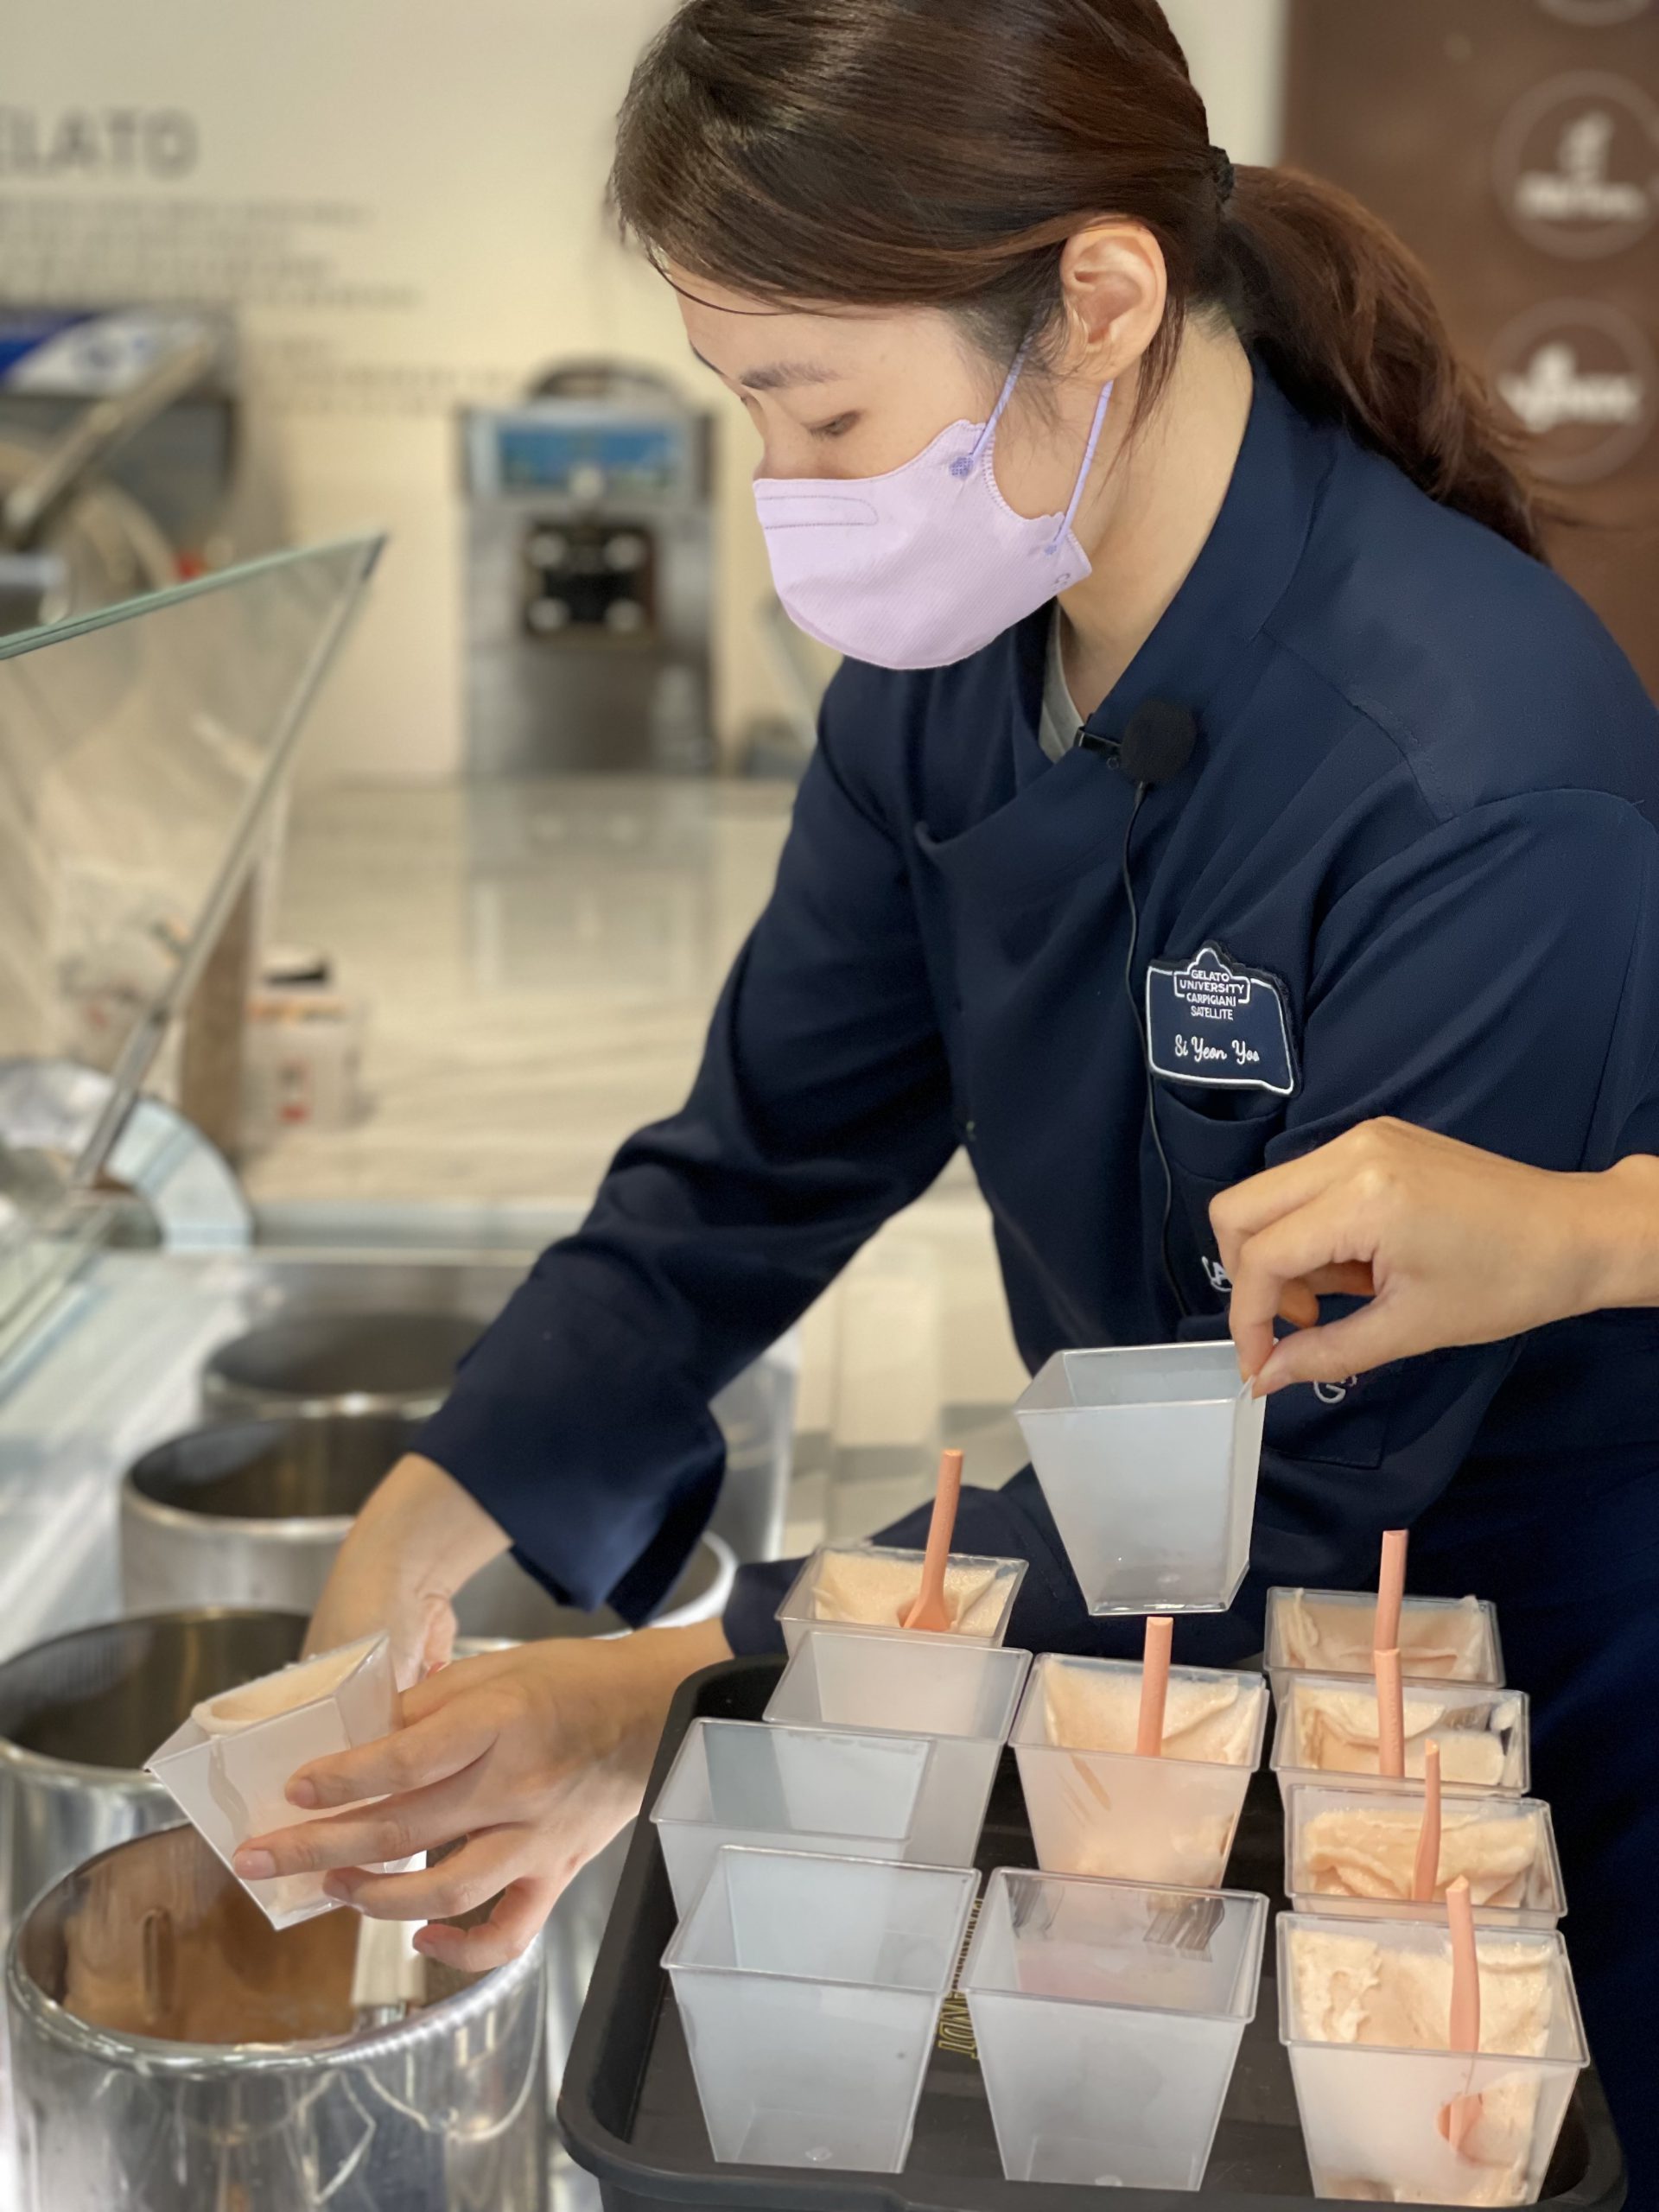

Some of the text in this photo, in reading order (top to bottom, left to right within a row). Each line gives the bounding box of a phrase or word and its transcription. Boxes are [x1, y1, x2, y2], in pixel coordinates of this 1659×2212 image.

[0, 106, 201, 179] LATO
[1192, 969, 1230, 982] GELATO
[1179, 979, 1244, 994] UNIVERSITY
[1186, 993, 1236, 1007] CARPIGIANI
[1191, 1006, 1234, 1020] SATELLITE
[1175, 1034, 1189, 1057] Si
[1191, 1036, 1228, 1062] Yeon
